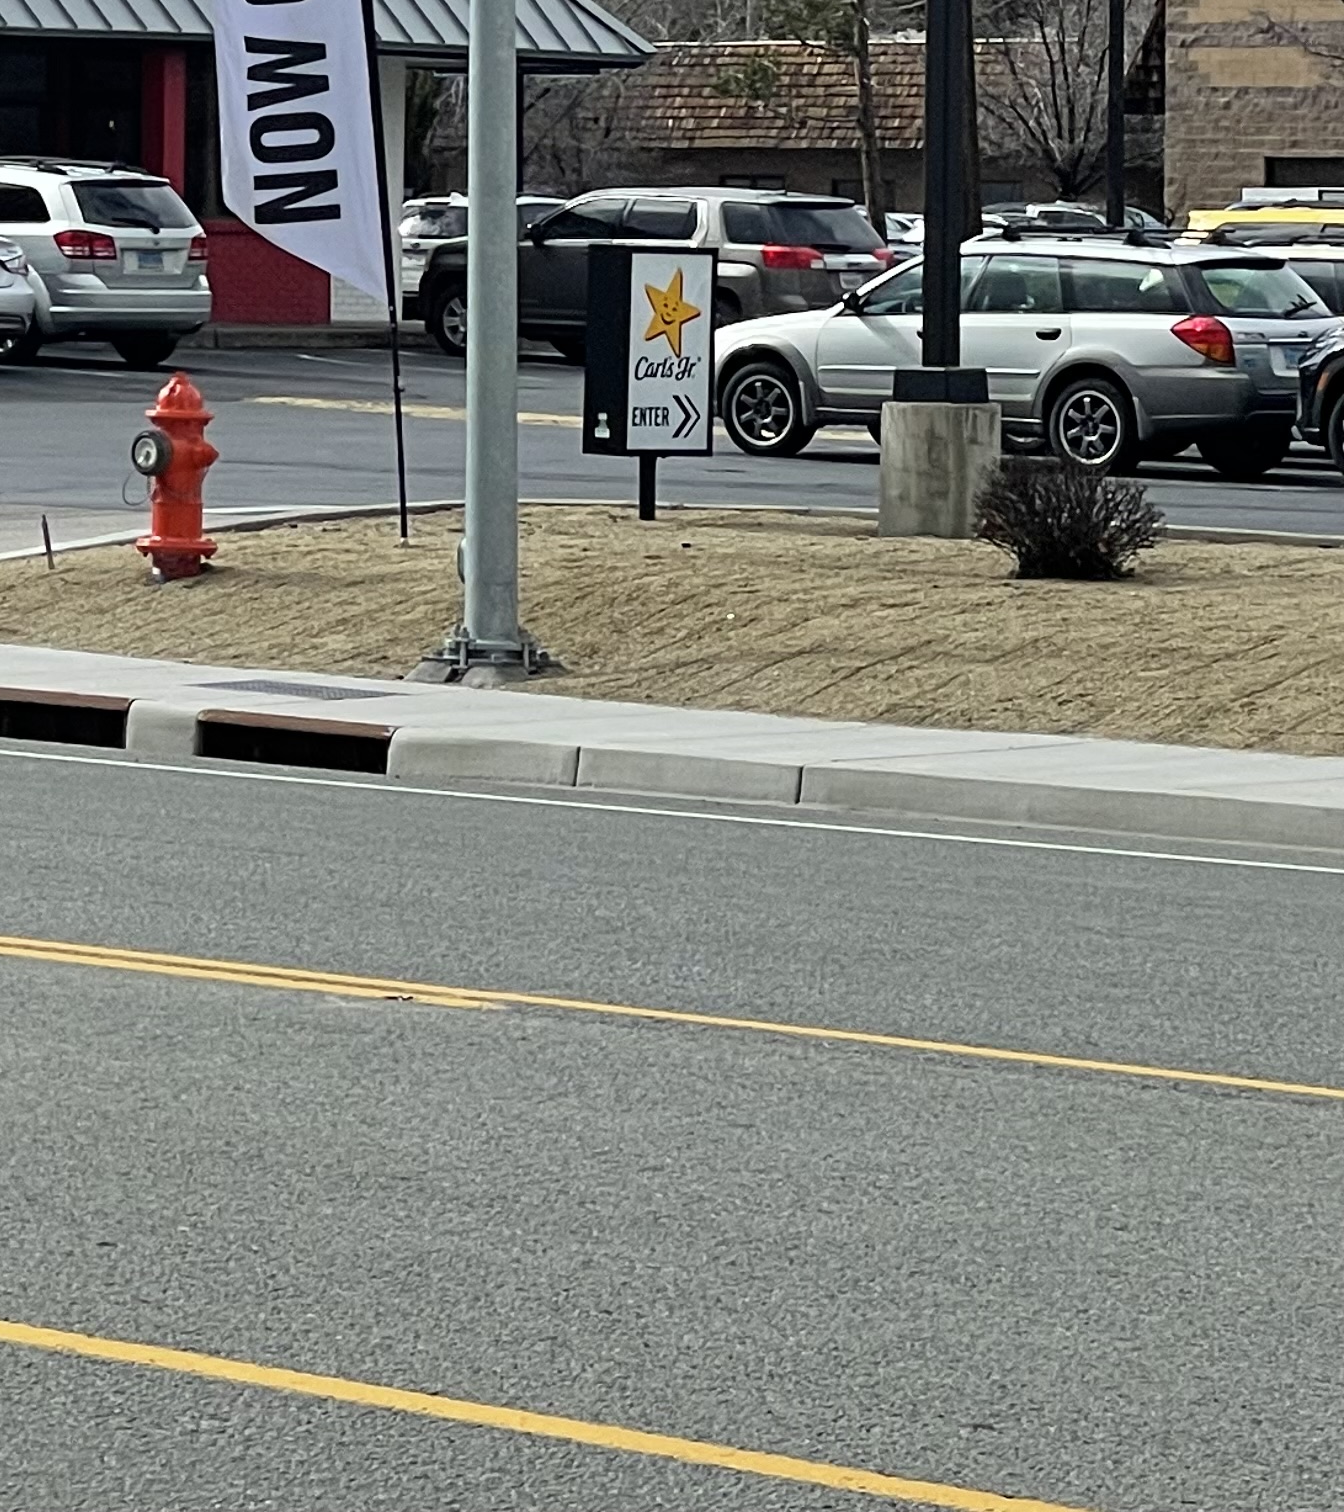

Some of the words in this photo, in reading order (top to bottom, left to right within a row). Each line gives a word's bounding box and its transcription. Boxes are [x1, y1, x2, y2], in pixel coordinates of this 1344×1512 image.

[245, 35, 342, 226] NOW
[634, 355, 675, 381] Carl's
[631, 406, 670, 427] ENTER
